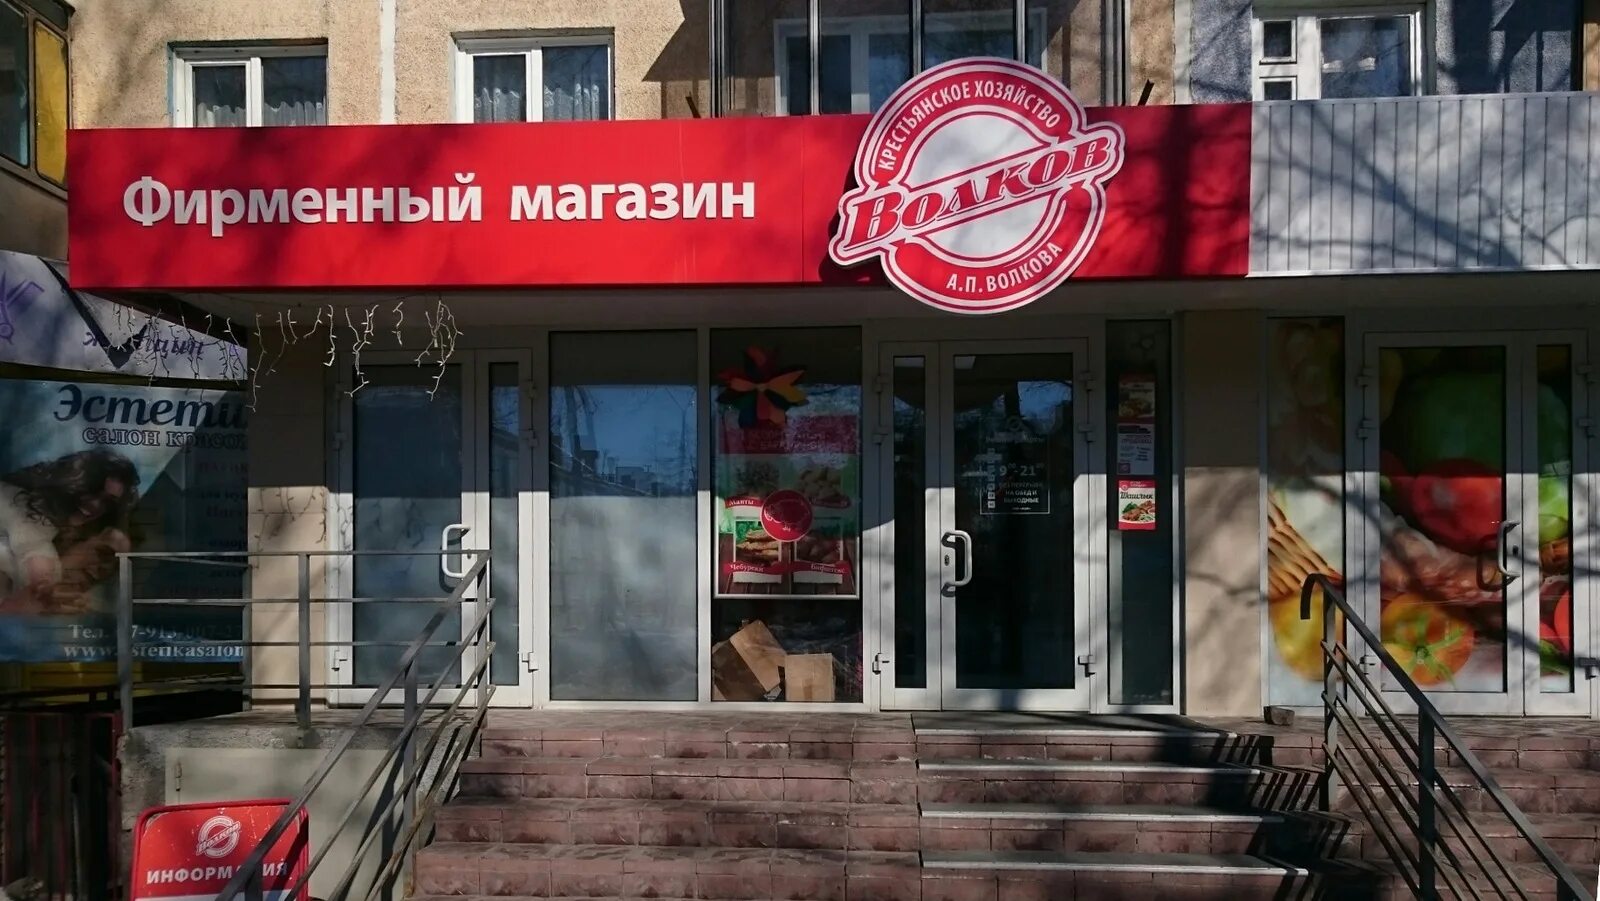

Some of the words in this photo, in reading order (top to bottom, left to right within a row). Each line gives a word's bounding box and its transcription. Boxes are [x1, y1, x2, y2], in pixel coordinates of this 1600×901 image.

[878, 83, 971, 171] КРЕСТЬЯНСКОЕ
[974, 79, 1061, 129] ХОЗЯЙСТВО
[123, 172, 482, 237] Фирменный
[510, 180, 755, 222] магазин
[986, 241, 1063, 293] ВОЛКОВА
[82, 427, 160, 447] салон
[146, 862, 288, 885] ИНФОРМИЯ
